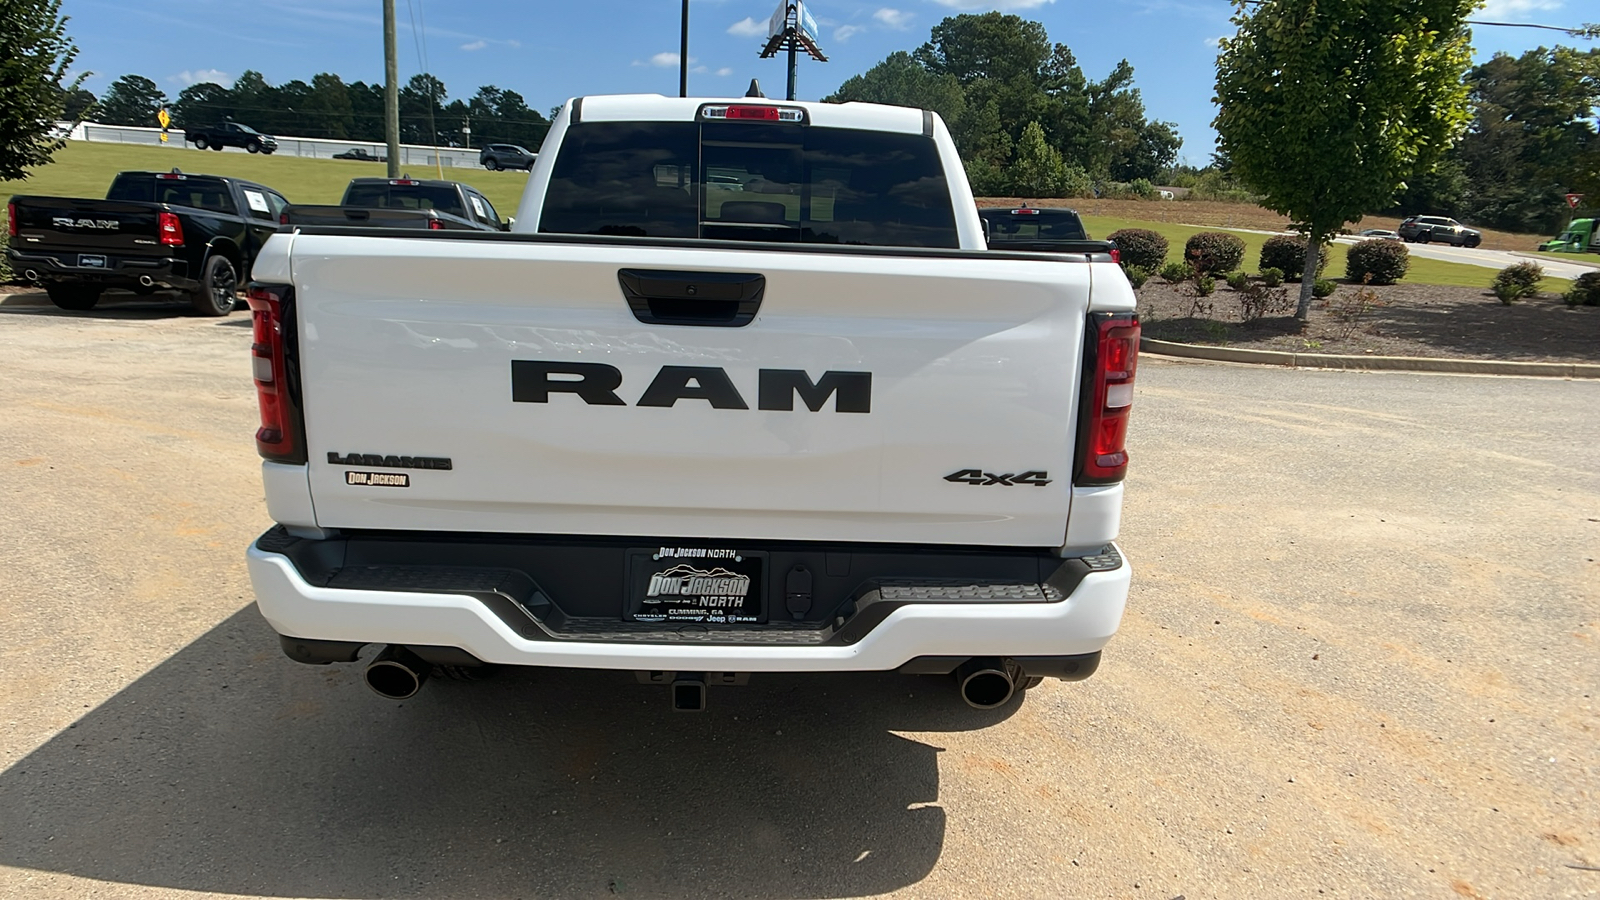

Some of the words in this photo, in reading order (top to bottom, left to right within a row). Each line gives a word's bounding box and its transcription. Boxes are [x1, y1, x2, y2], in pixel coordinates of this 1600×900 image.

[52, 217, 119, 230] RAM
[511, 360, 872, 413] RAM
[327, 452, 452, 470] LARAMIE
[943, 469, 1053, 486] 4x4
[707, 549, 736, 559] NORTH
[699, 596, 744, 607] NORTH
[706, 615, 726, 623] Jeep
